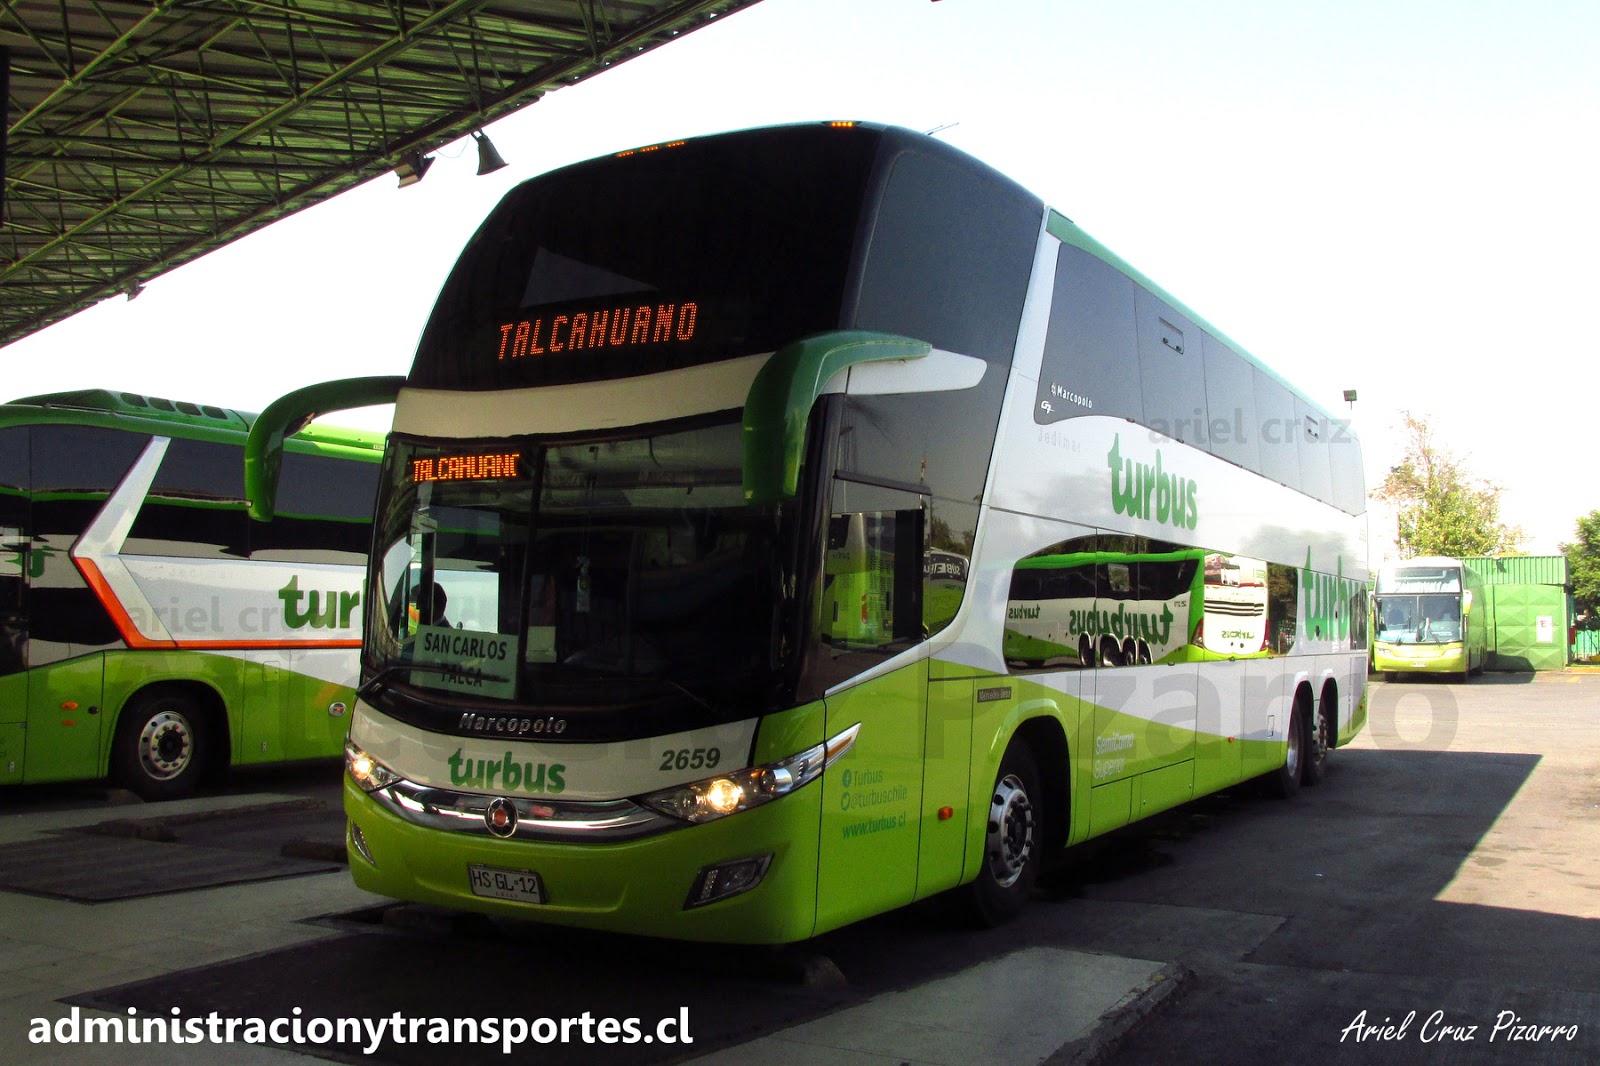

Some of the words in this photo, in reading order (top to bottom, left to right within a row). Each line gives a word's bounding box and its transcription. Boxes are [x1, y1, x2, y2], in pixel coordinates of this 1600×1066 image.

[498, 302, 698, 360] TALCAHUANO
[1056, 385, 1093, 409] Marcopolo
[1107, 432, 1198, 531] turbus
[278, 575, 365, 629] tur
[424, 632, 450, 654] SAN
[453, 635, 507, 661] CARLOS
[459, 711, 568, 735] Marcopolo
[448, 748, 566, 795] turbus
[658, 747, 721, 772] 2659
[854, 769, 883, 786] Turbus
